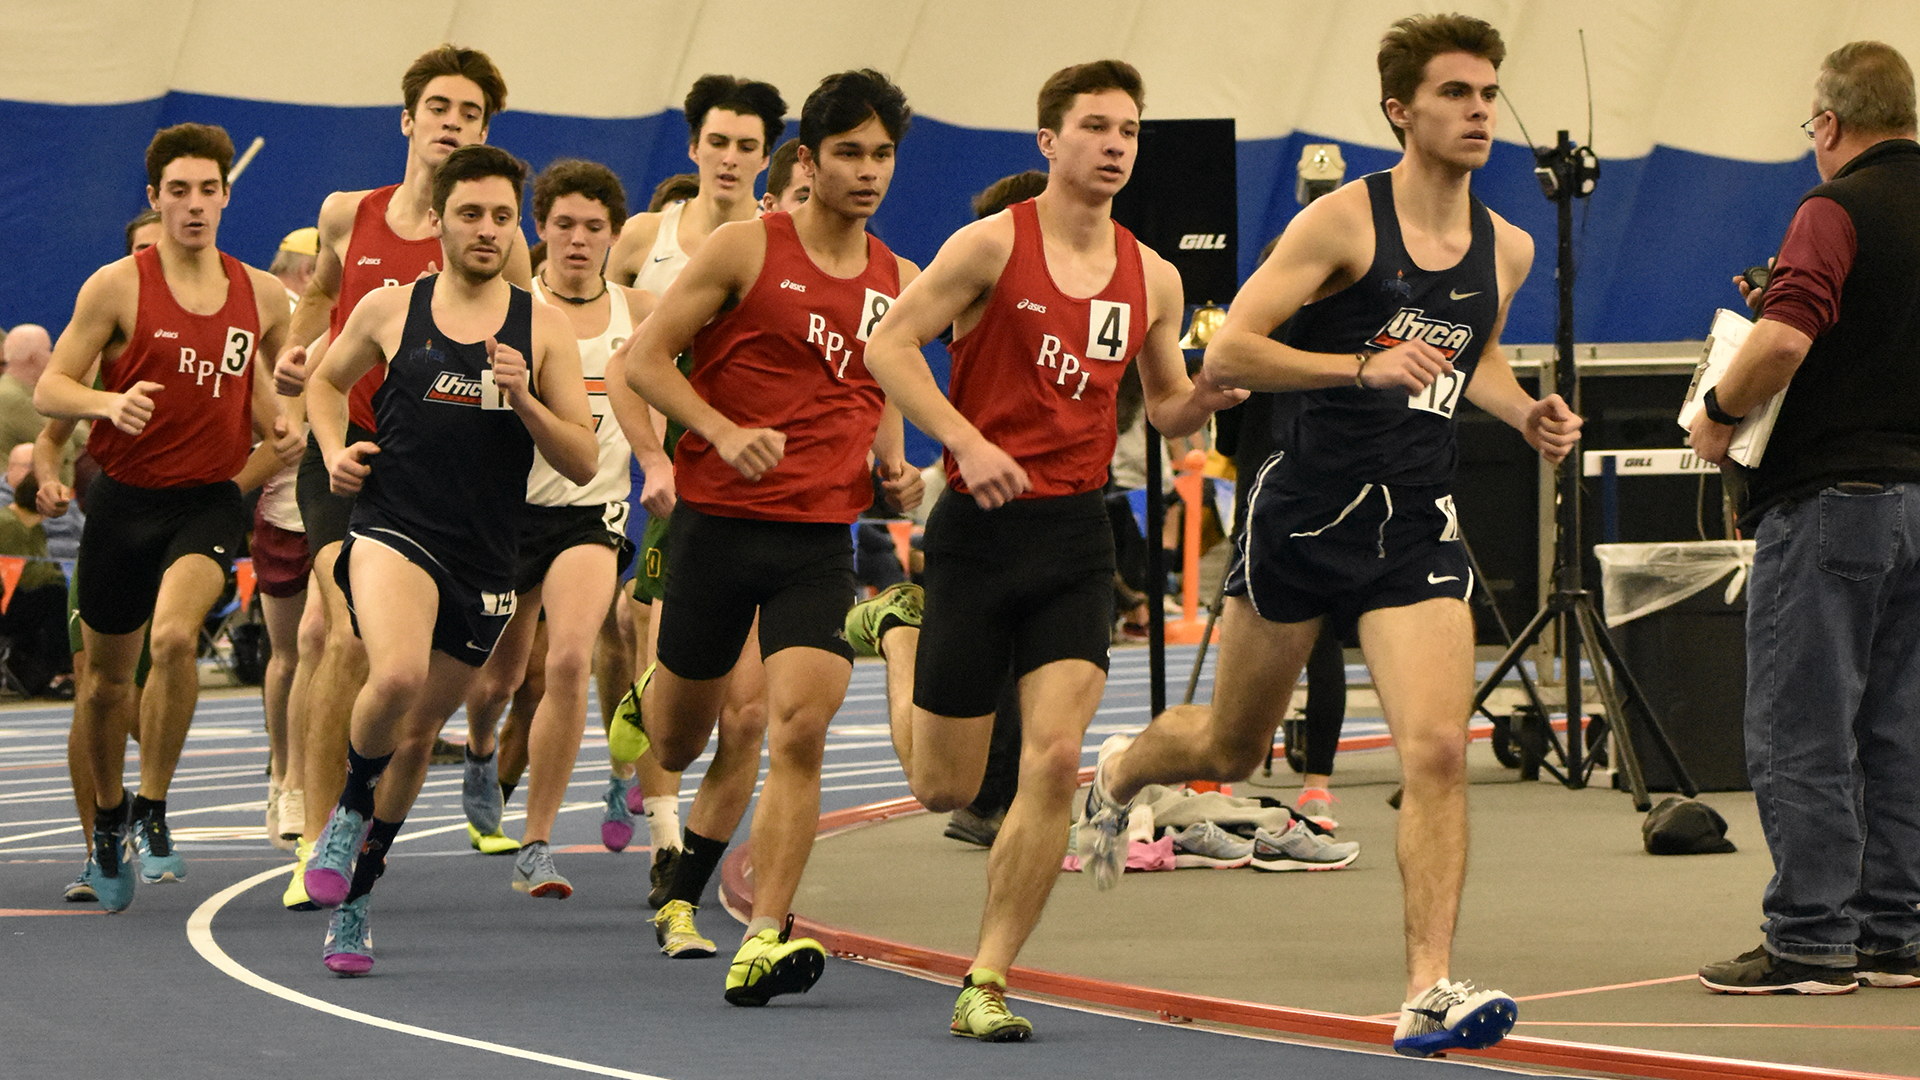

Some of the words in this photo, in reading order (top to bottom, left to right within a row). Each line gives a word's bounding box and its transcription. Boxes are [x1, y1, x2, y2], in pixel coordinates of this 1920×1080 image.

[1178, 233, 1227, 250] GILL
[866, 296, 890, 338] 8
[1097, 306, 1122, 357] 4
[1387, 311, 1469, 349] UTICA
[226, 332, 249, 372] 3
[806, 312, 853, 379] RPI
[178, 346, 223, 398] RPI
[434, 374, 483, 397] UTIC
[1036, 333, 1091, 401] RPI
